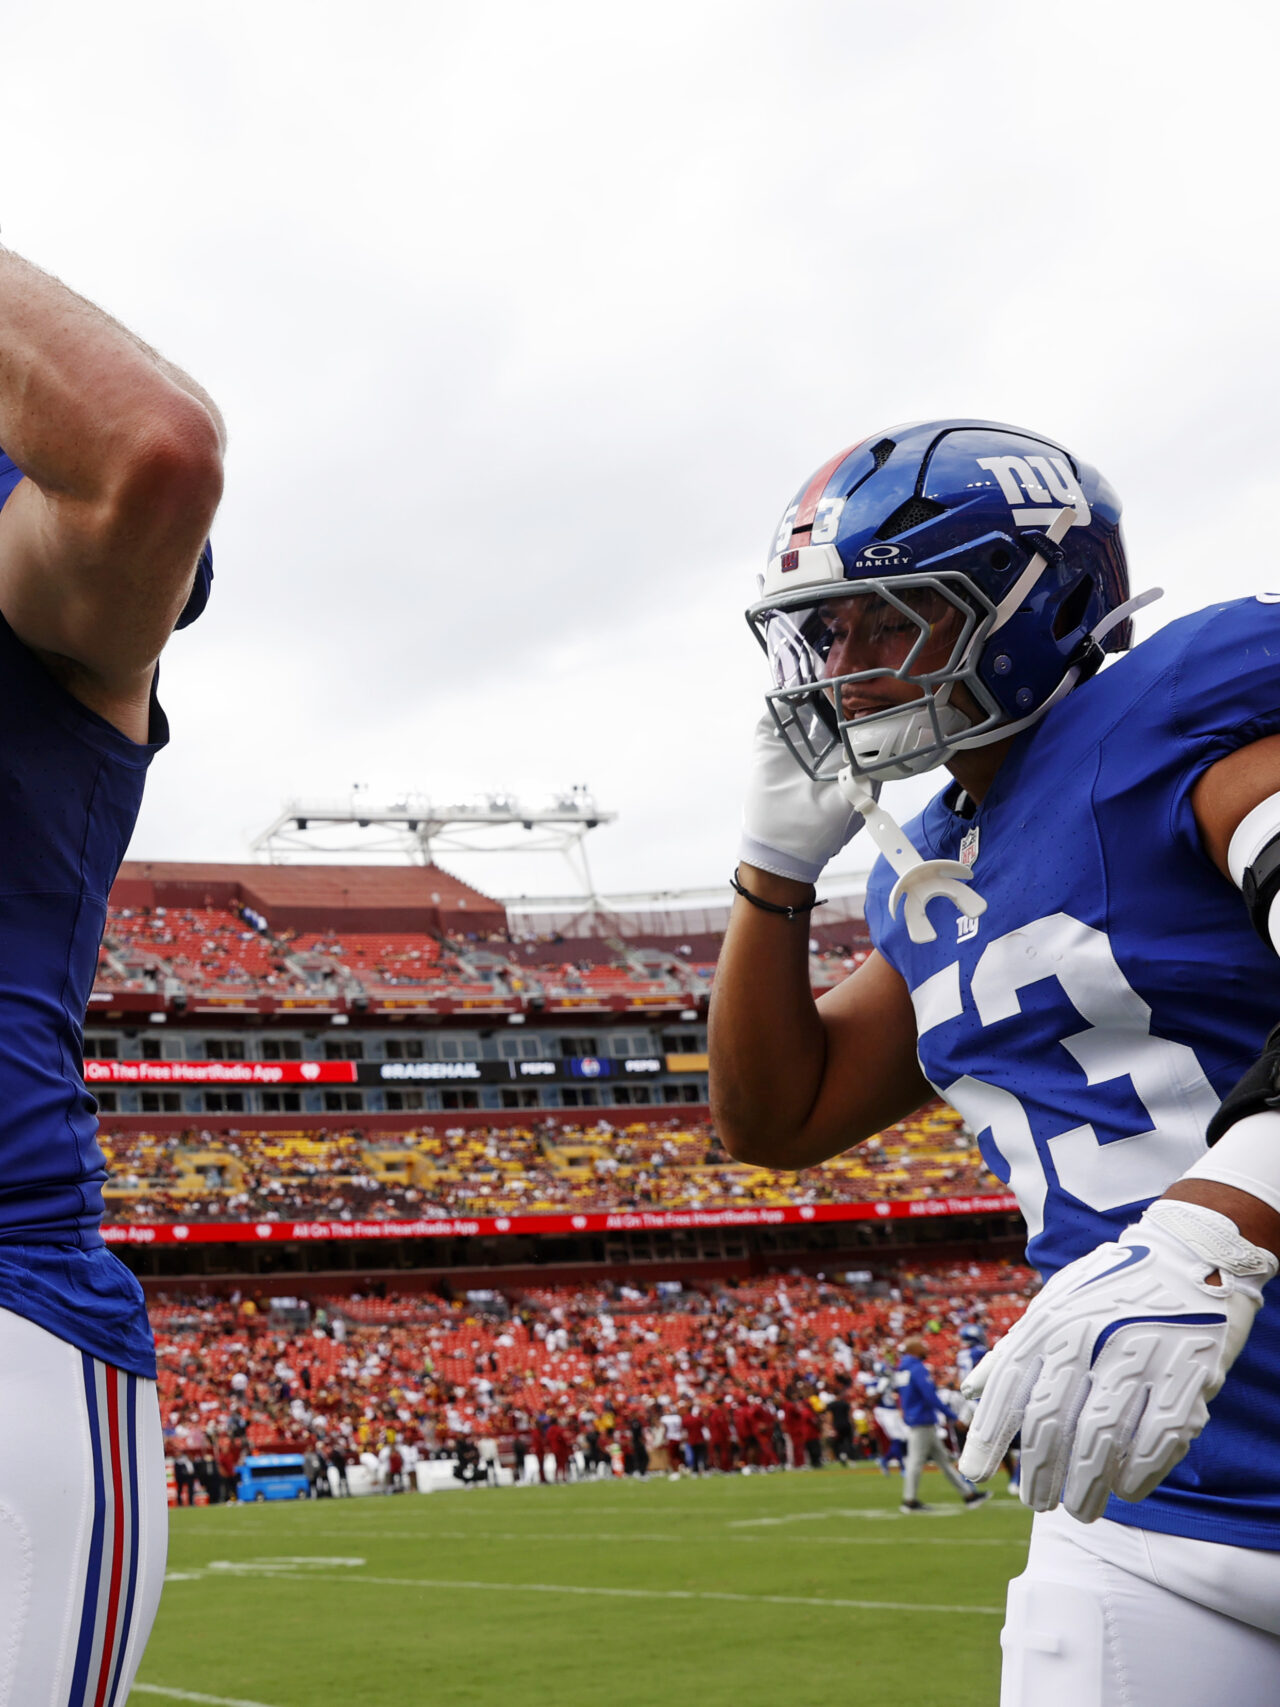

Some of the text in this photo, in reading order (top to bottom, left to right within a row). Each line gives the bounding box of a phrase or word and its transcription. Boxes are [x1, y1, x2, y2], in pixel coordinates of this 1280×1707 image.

[856, 557, 909, 568] OAKLEY
[87, 1063, 110, 1078] On
[111, 1063, 138, 1079] The
[139, 1063, 170, 1080] Free
[172, 1063, 252, 1080] iHeartRadio
[253, 1064, 283, 1082] App
[128, 1226, 156, 1243] App
